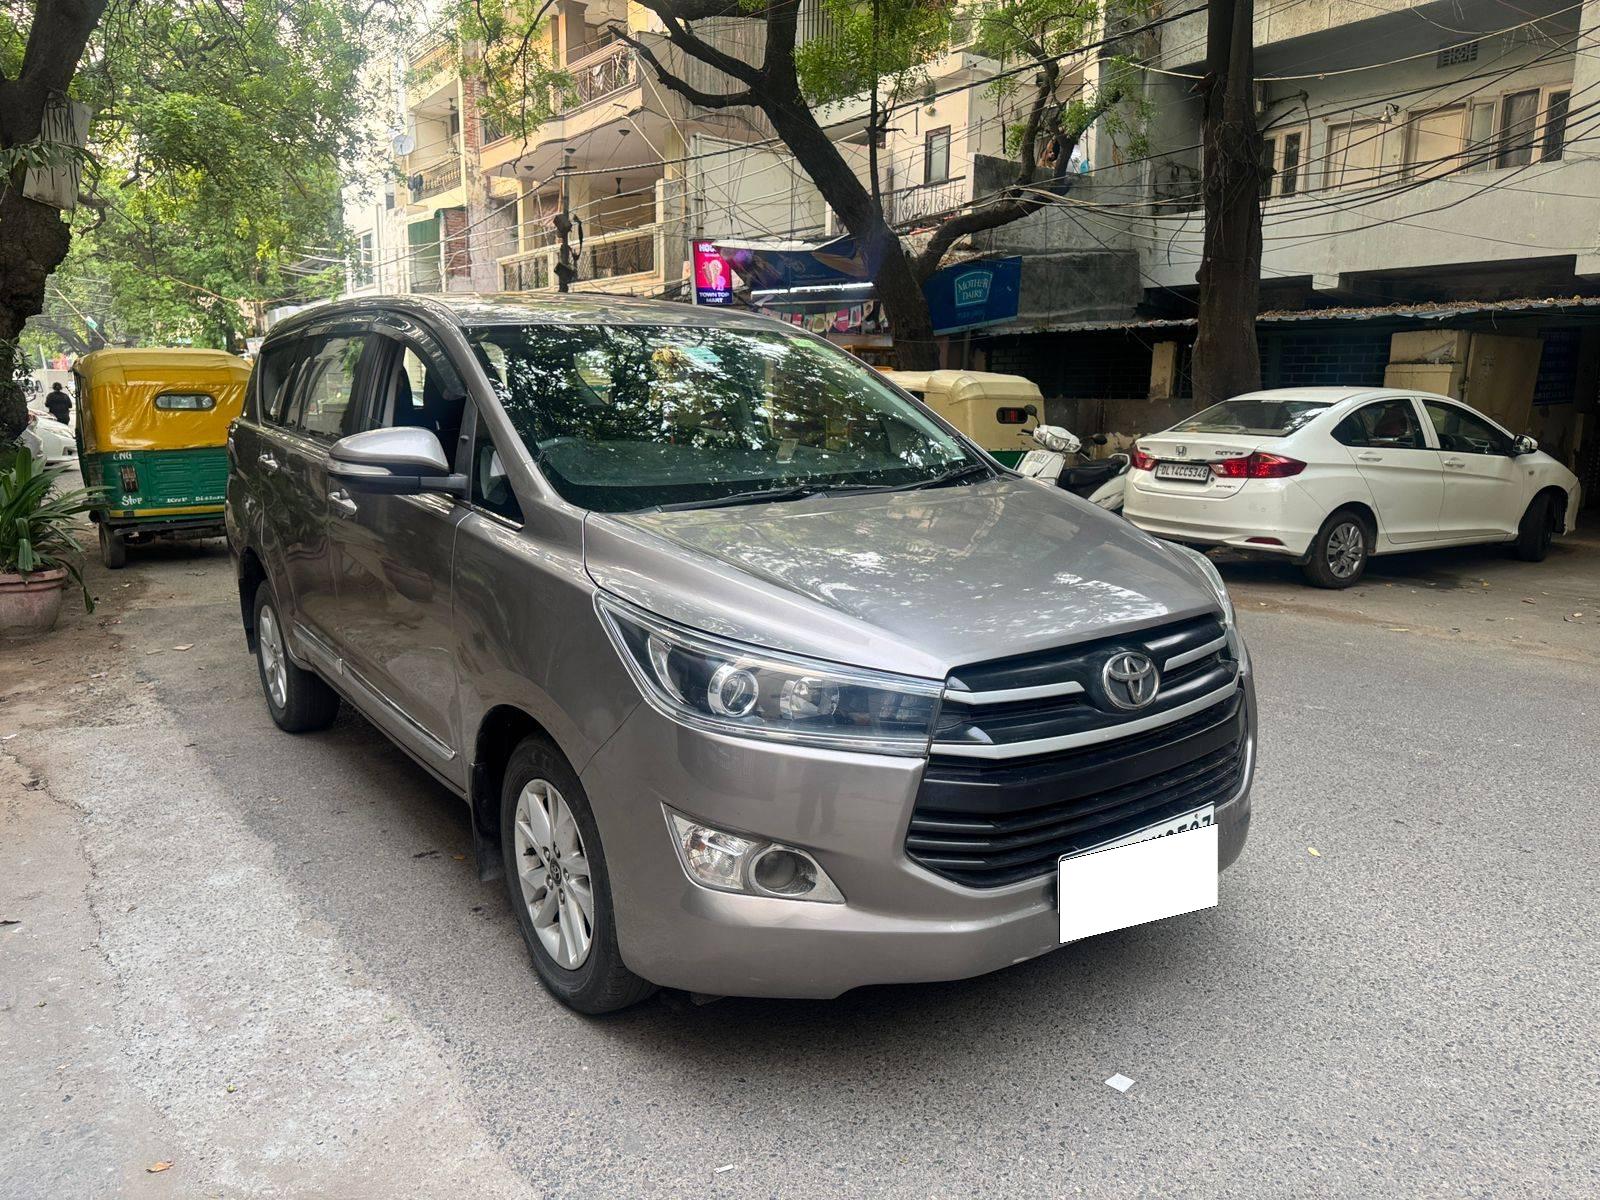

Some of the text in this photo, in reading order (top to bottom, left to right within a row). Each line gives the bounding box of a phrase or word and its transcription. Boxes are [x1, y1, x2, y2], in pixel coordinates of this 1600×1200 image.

[957, 279, 988, 290] MOTHER
[962, 289, 984, 299] DAIRY
[113, 452, 132, 461] CNG
[121, 495, 143, 506] Stop
